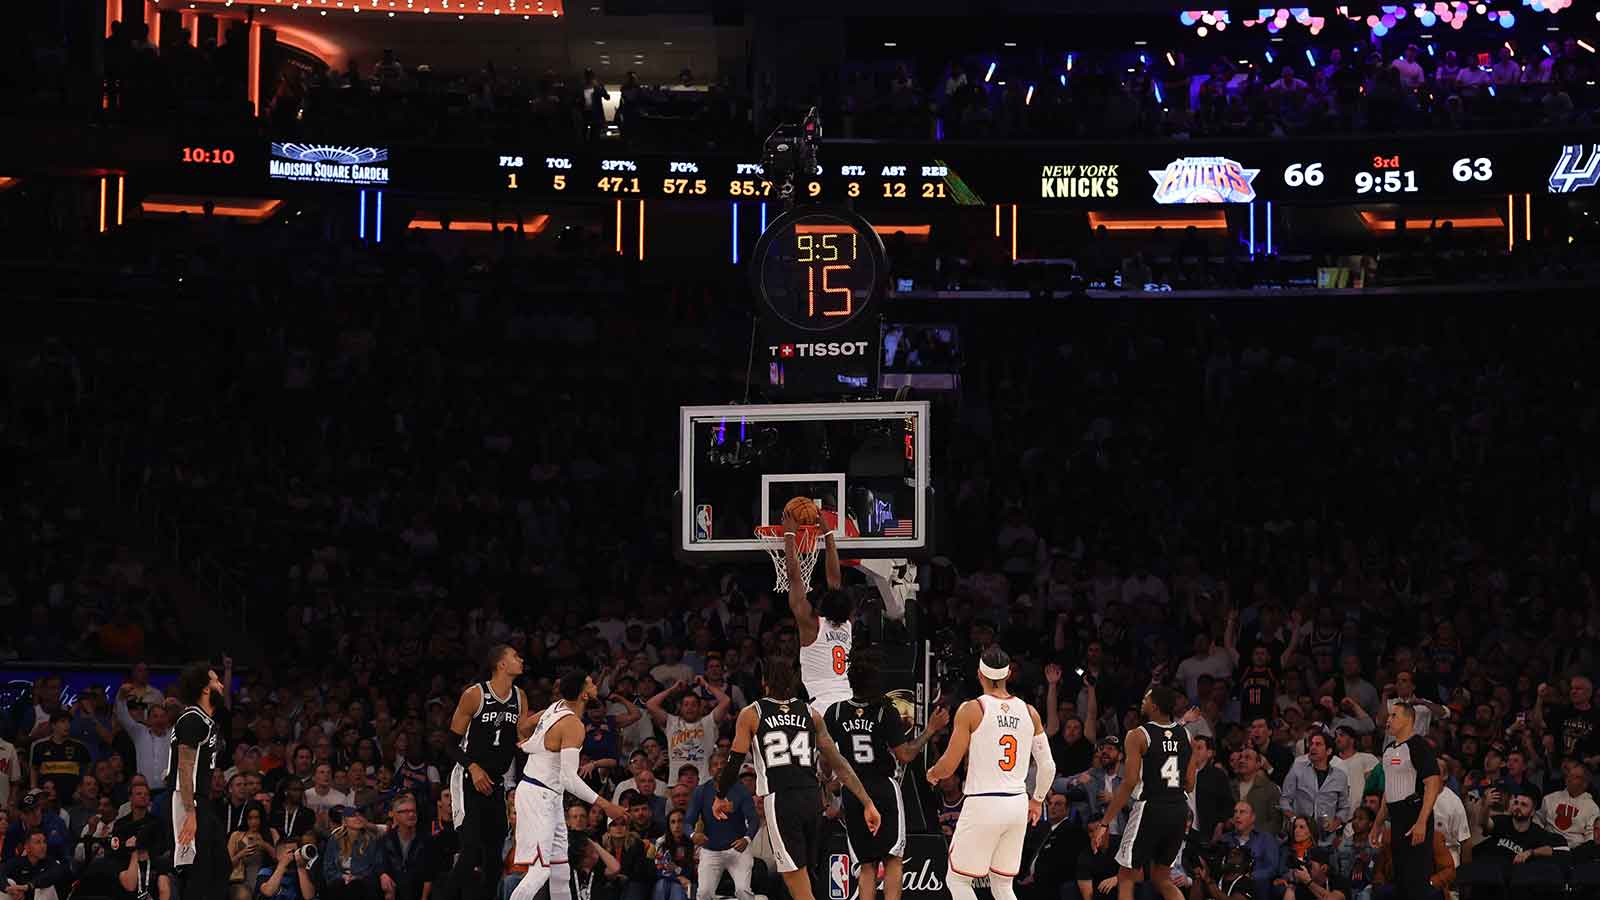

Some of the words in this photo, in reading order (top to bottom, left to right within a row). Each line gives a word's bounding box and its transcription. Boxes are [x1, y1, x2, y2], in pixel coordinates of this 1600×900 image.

[181, 147, 236, 165] 10:10
[499, 155, 524, 167] FLS
[546, 157, 572, 169] TOL
[601, 160, 637, 172] 3PT%
[670, 161, 699, 173] FG%
[736, 163, 765, 175] FT%
[841, 165, 866, 177] STL
[881, 166, 907, 177] AST
[921, 166, 949, 177] REB
[1372, 155, 1400, 168] 3rd
[269, 159, 313, 177] MADISON
[314, 161, 351, 179] SQUARE
[352, 164, 389, 181] GARDEN
[1042, 165, 1078, 177] NEW
[1078, 164, 1119, 177] YORK
[1157, 162, 1252, 198] KNICKS
[1284, 162, 1325, 187] 66
[1452, 157, 1493, 182] 63
[506, 173, 519, 189] 1
[553, 174, 566, 190] 5
[597, 176, 641, 193] 47.1
[662, 178, 707, 194] 57.5
[729, 180, 772, 196] 85.7
[807, 181, 822, 197] 9
[847, 182, 861, 197] 3
[883, 182, 907, 198] 12
[921, 183, 947, 198] 21
[1041, 177, 1119, 198] KNICKS
[1354, 169, 1419, 194] 9:51
[797, 233, 858, 262] 9:51
[807, 264, 852, 318] 15
[769, 346, 779, 356] T
[796, 341, 868, 357] TISSOT
[831, 644, 847, 676] 8
[764, 713, 807, 729] VASSELL
[842, 718, 875, 733] CASTLE
[997, 714, 1020, 729] HART
[491, 728, 502, 747] 1
[851, 733, 875, 763] 5
[1162, 740, 1179, 753] FOX
[763, 730, 812, 769] 24
[999, 734, 1018, 772] 3
[1160, 754, 1181, 788] 4
